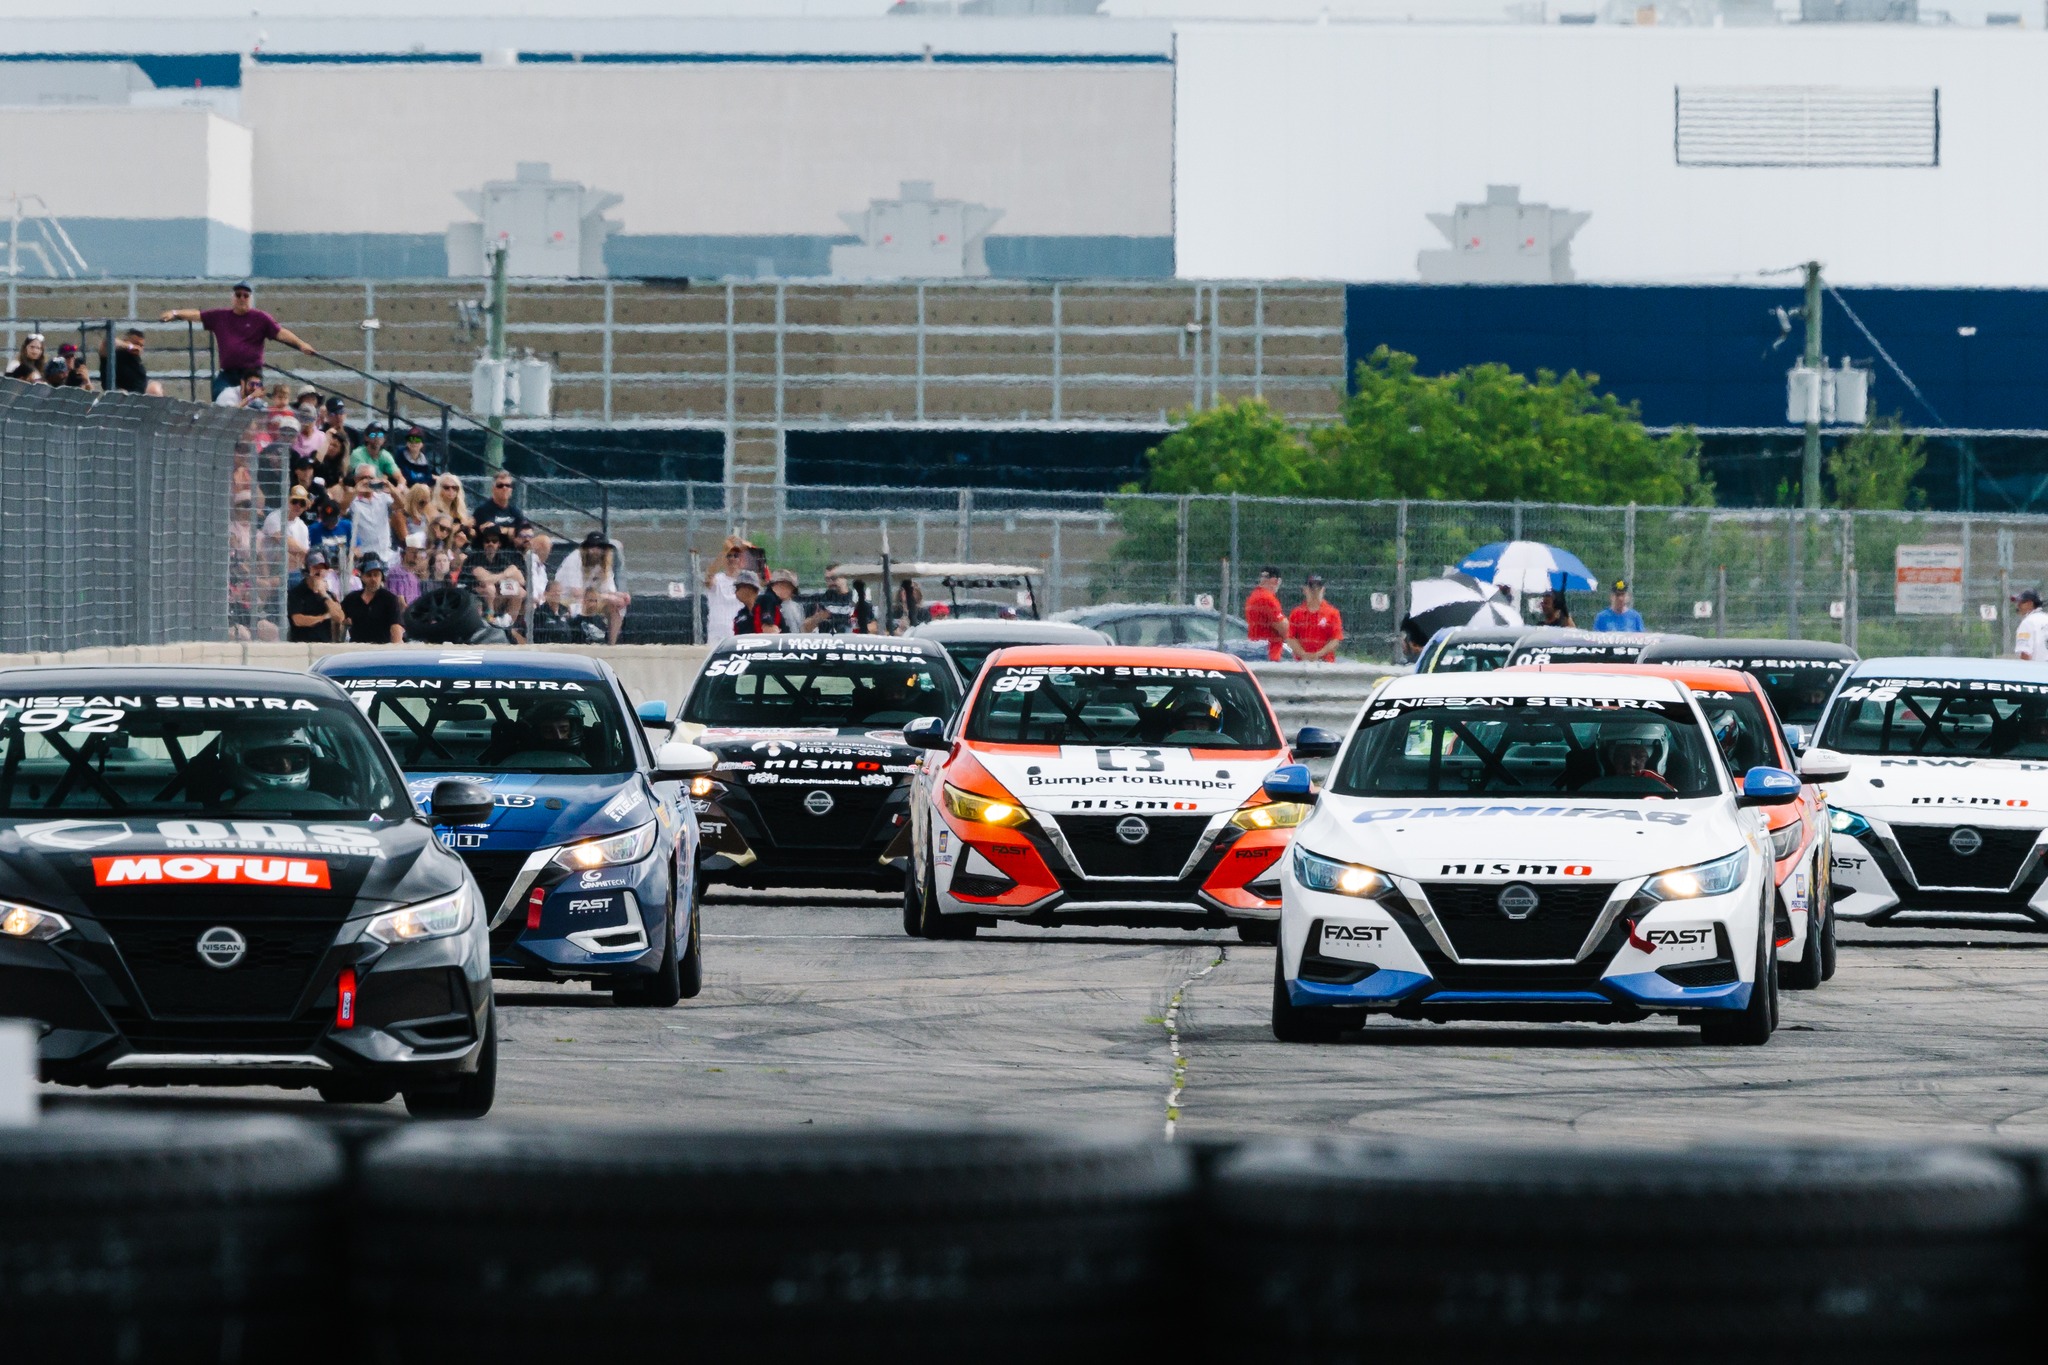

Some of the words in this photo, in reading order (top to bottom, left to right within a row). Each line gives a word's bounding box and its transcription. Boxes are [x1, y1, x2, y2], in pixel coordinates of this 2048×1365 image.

[1457, 643, 1513, 651] NISSA
[1531, 647, 1606, 655] NISSAN
[730, 652, 818, 661] NISSAN
[826, 653, 927, 664] SENTRA
[1662, 659, 1743, 668] NISSAN
[1751, 660, 1843, 670] SENTRA
[705, 660, 750, 676] 50
[1006, 666, 1104, 676] NISSAN
[1114, 667, 1226, 679] SENTRA
[453, 680, 585, 691] SENTRA
[992, 675, 1044, 693] 95
[1867, 679, 1961, 689] NISSAN
[1837, 686, 1904, 702] 46
[0, 696, 141, 709] NISSAN
[155, 696, 319, 711] SENTRA
[1393, 697, 1514, 708] NISSAN
[1526, 697, 1666, 710] SENTRA
[1370, 708, 1401, 720] 99
[764, 759, 881, 770] nismo
[1028, 775, 1117, 786] Bumper
[1122, 775, 1144, 783] to
[1149, 776, 1236, 790] Bumper
[1071, 799, 1198, 811] nismo
[1912, 797, 2029, 807] nismo
[1352, 806, 1692, 826] OMNIFAB
[166, 839, 257, 849] NORTH
[264, 840, 387, 860] AMERICA
[992, 845, 1030, 856] FAST
[1236, 848, 1273, 858] FAST
[106, 857, 318, 884] MOTUL
[1440, 863, 1592, 876] nismo
[569, 897, 613, 911] FAST
[1324, 925, 1390, 941] FAST
[1646, 928, 1712, 944] FAST
[202, 943, 241, 951] NISSAN
